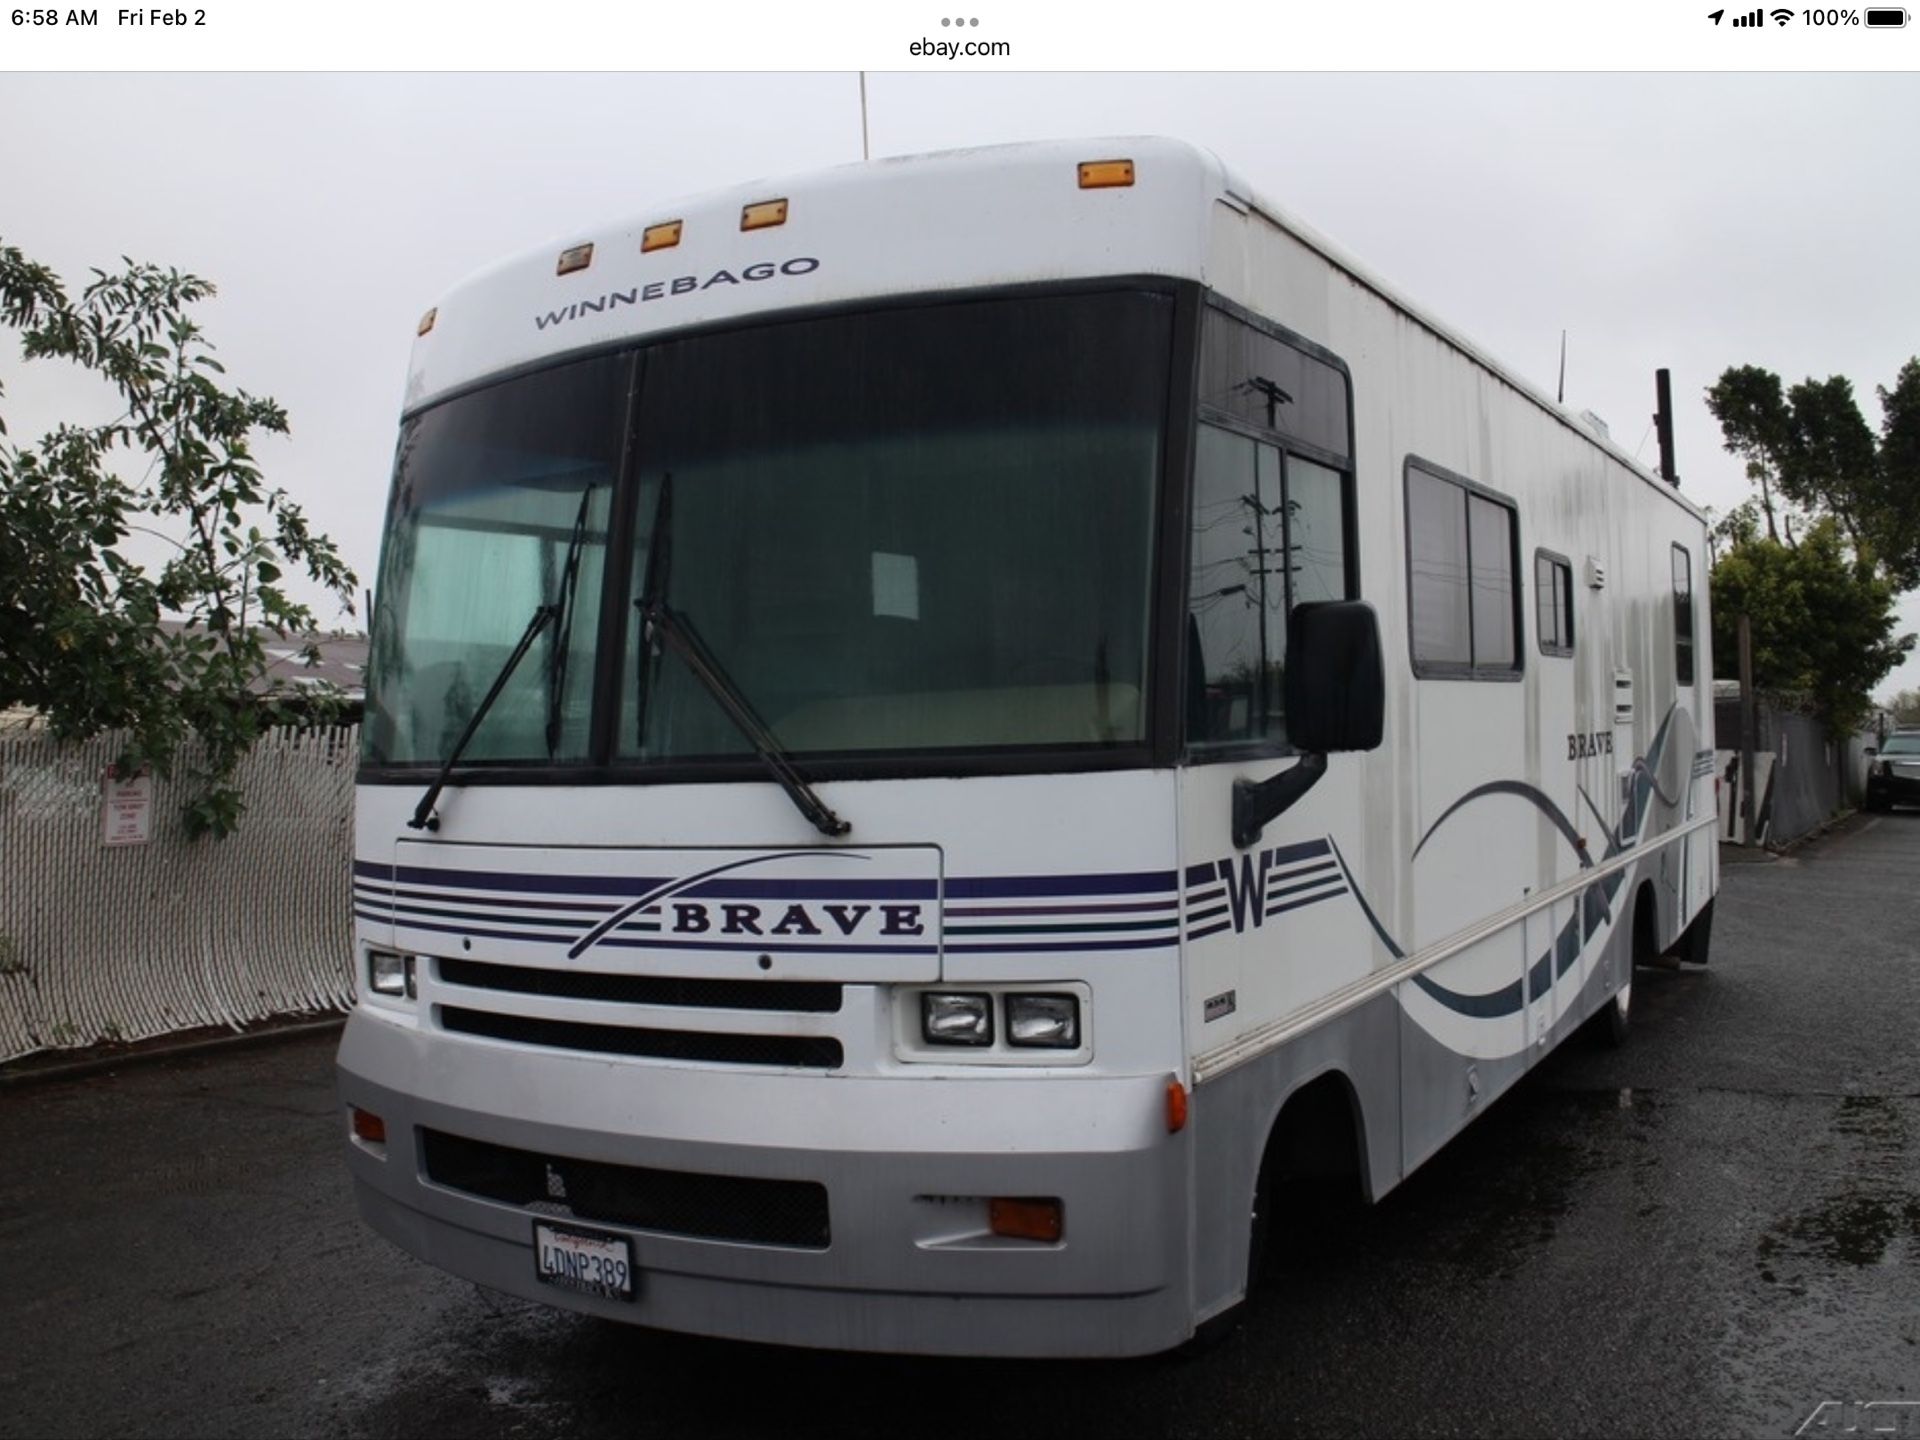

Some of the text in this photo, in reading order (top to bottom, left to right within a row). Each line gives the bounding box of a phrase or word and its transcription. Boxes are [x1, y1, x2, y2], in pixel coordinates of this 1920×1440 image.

[535, 257, 820, 330] WINNEBAGO
[1567, 731, 1613, 760] BRAVE
[1218, 849, 1273, 934] W
[672, 903, 925, 935] BRAVE
[543, 1244, 627, 1289] 4DNP389
